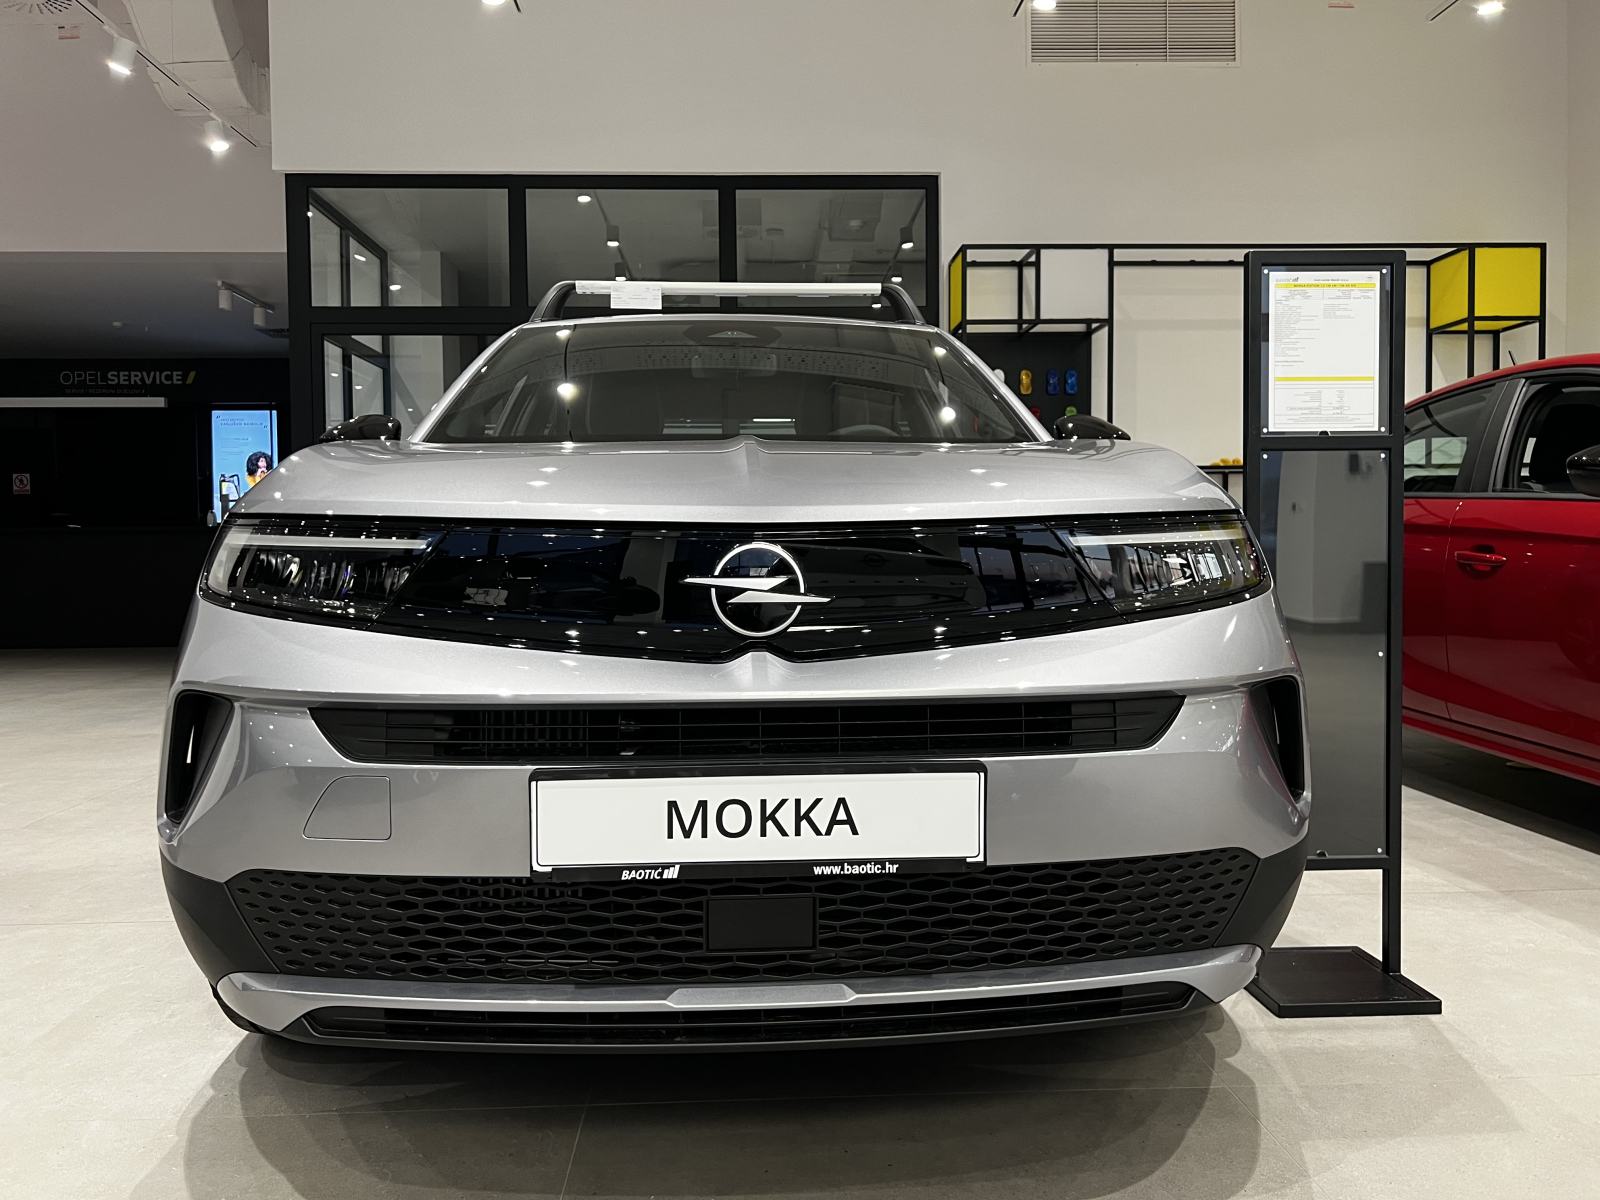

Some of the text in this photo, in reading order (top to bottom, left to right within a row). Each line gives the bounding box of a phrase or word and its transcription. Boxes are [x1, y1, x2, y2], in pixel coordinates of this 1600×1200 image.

[666, 797, 860, 840] MOKKA
[621, 867, 662, 880] BAOTIĆ
[813, 861, 899, 875] www.baotic.hr
